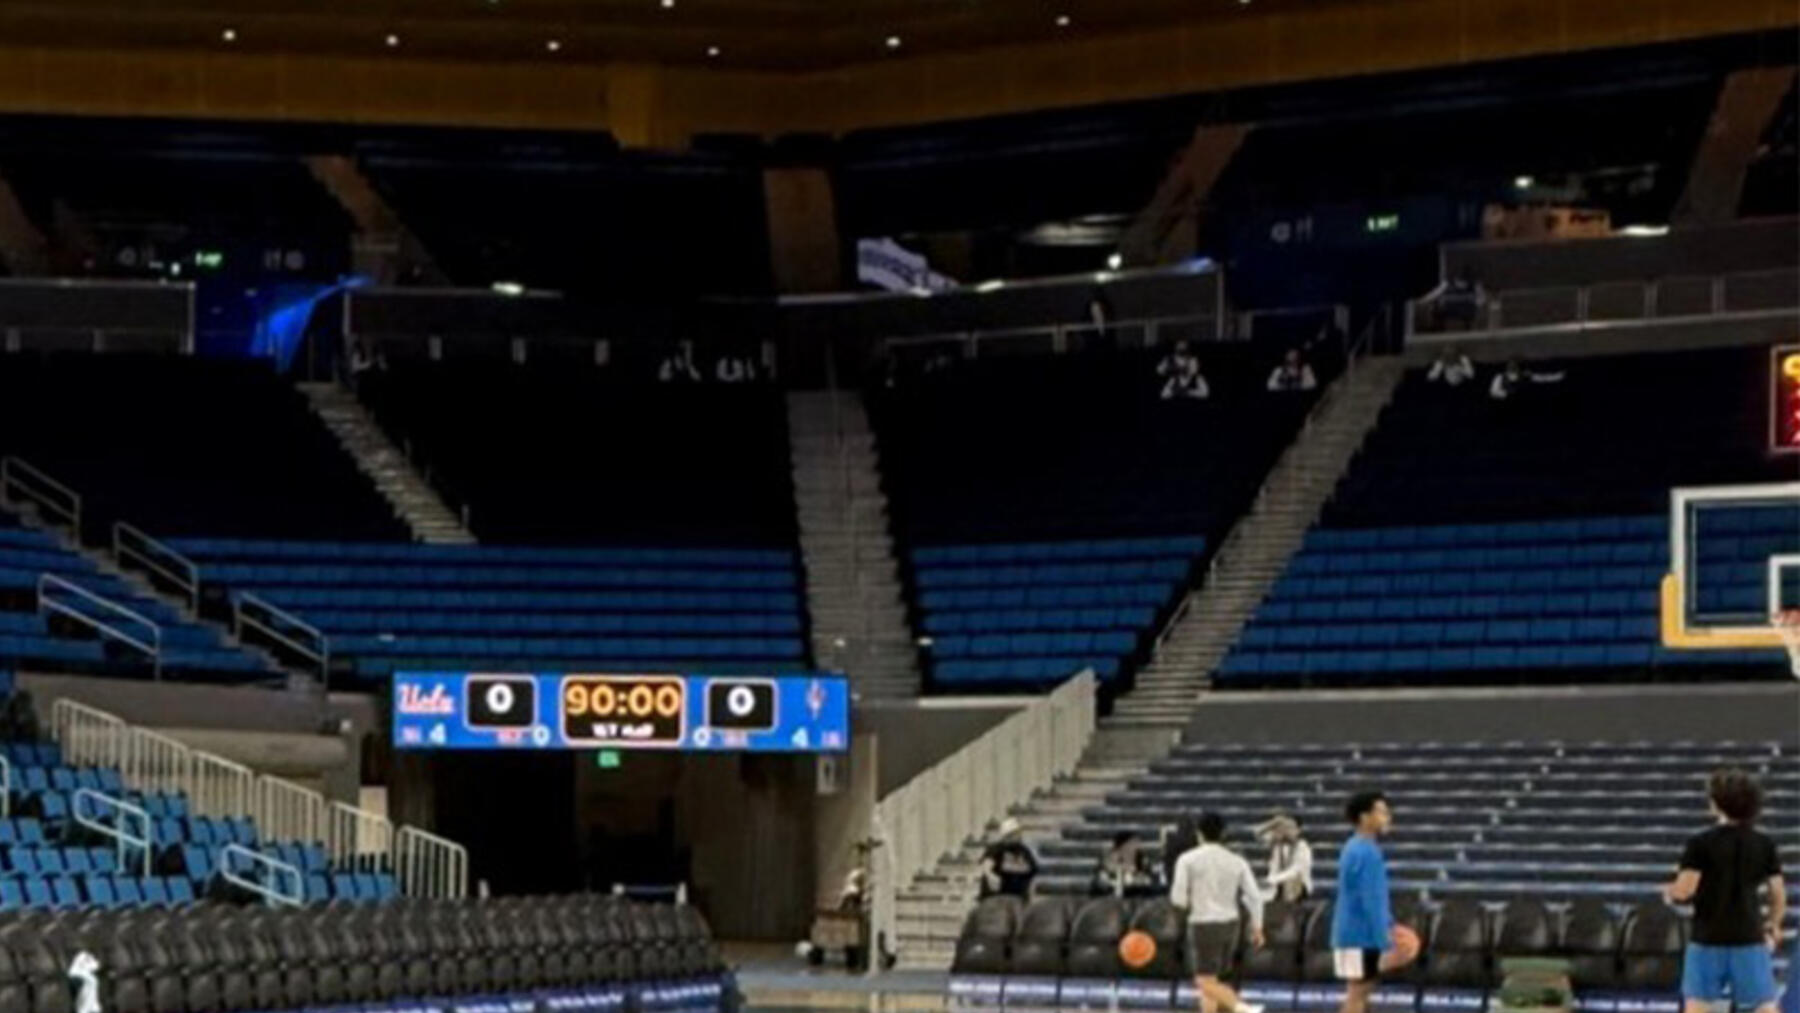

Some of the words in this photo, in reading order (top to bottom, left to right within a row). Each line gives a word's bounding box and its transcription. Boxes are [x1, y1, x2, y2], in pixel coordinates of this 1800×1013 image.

[487, 684, 513, 713] 0
[566, 684, 680, 716] 90:00
[728, 687, 754, 716] 0
